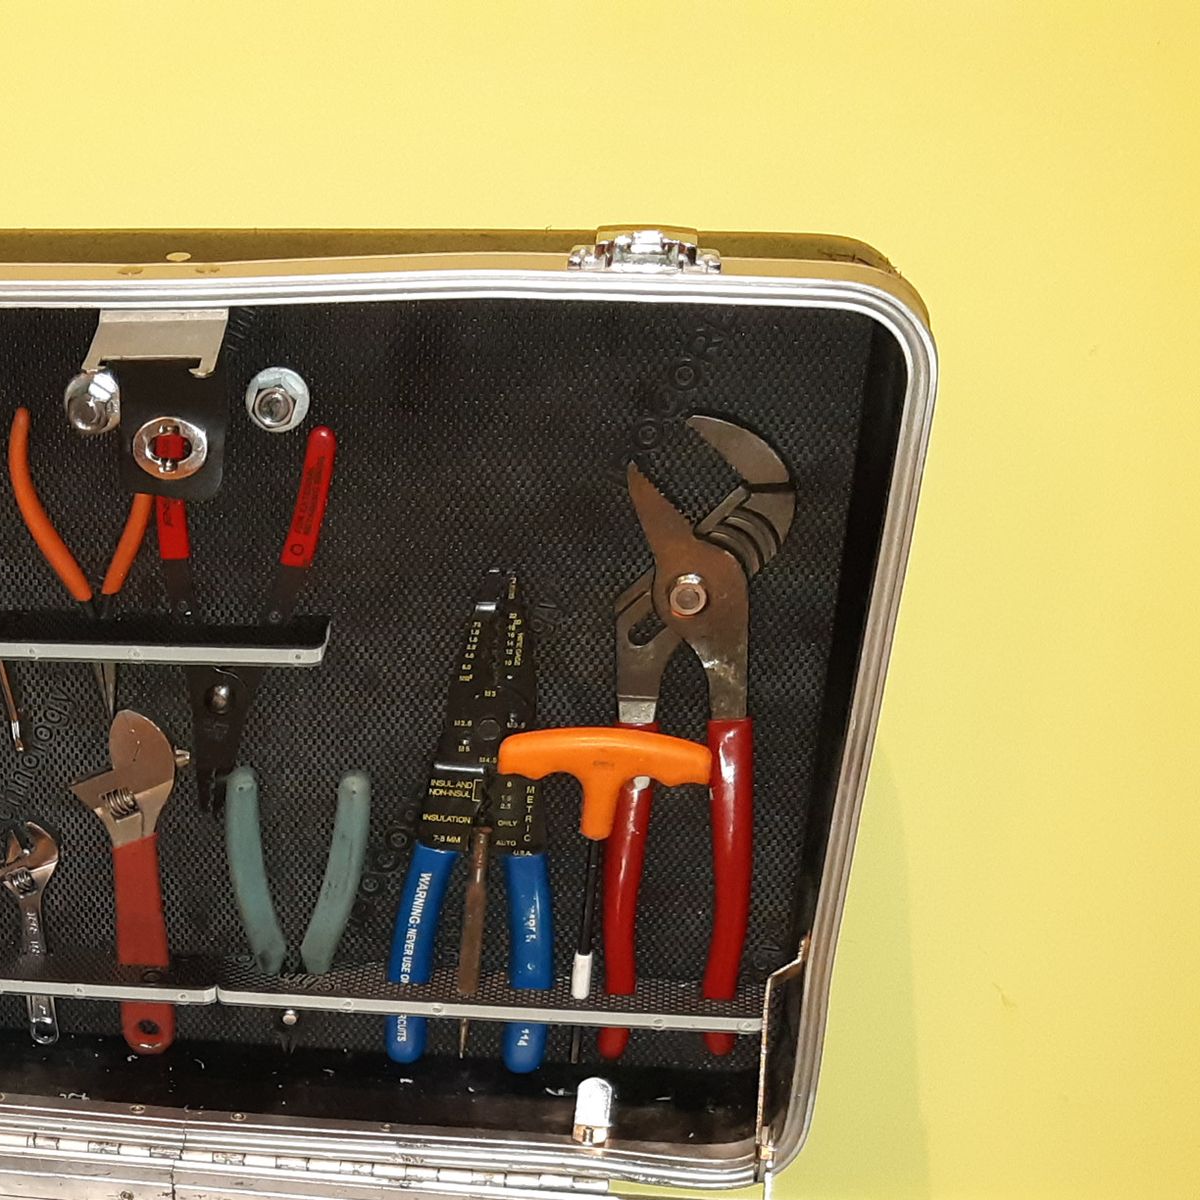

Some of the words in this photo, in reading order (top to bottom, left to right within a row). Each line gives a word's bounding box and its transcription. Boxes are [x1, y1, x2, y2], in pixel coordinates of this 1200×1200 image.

[430, 779, 456, 789] INSUL
[456, 781, 473, 789] AND
[428, 788, 471, 798] NON-INSUL
[422, 813, 471, 824] INSULATION
[523, 785, 535, 842] METRIC
[446, 835, 461, 843] MM
[407, 872, 432, 928] WARNING:
[404, 927, 417, 956] NEVER
[401, 954, 413, 974] USE
